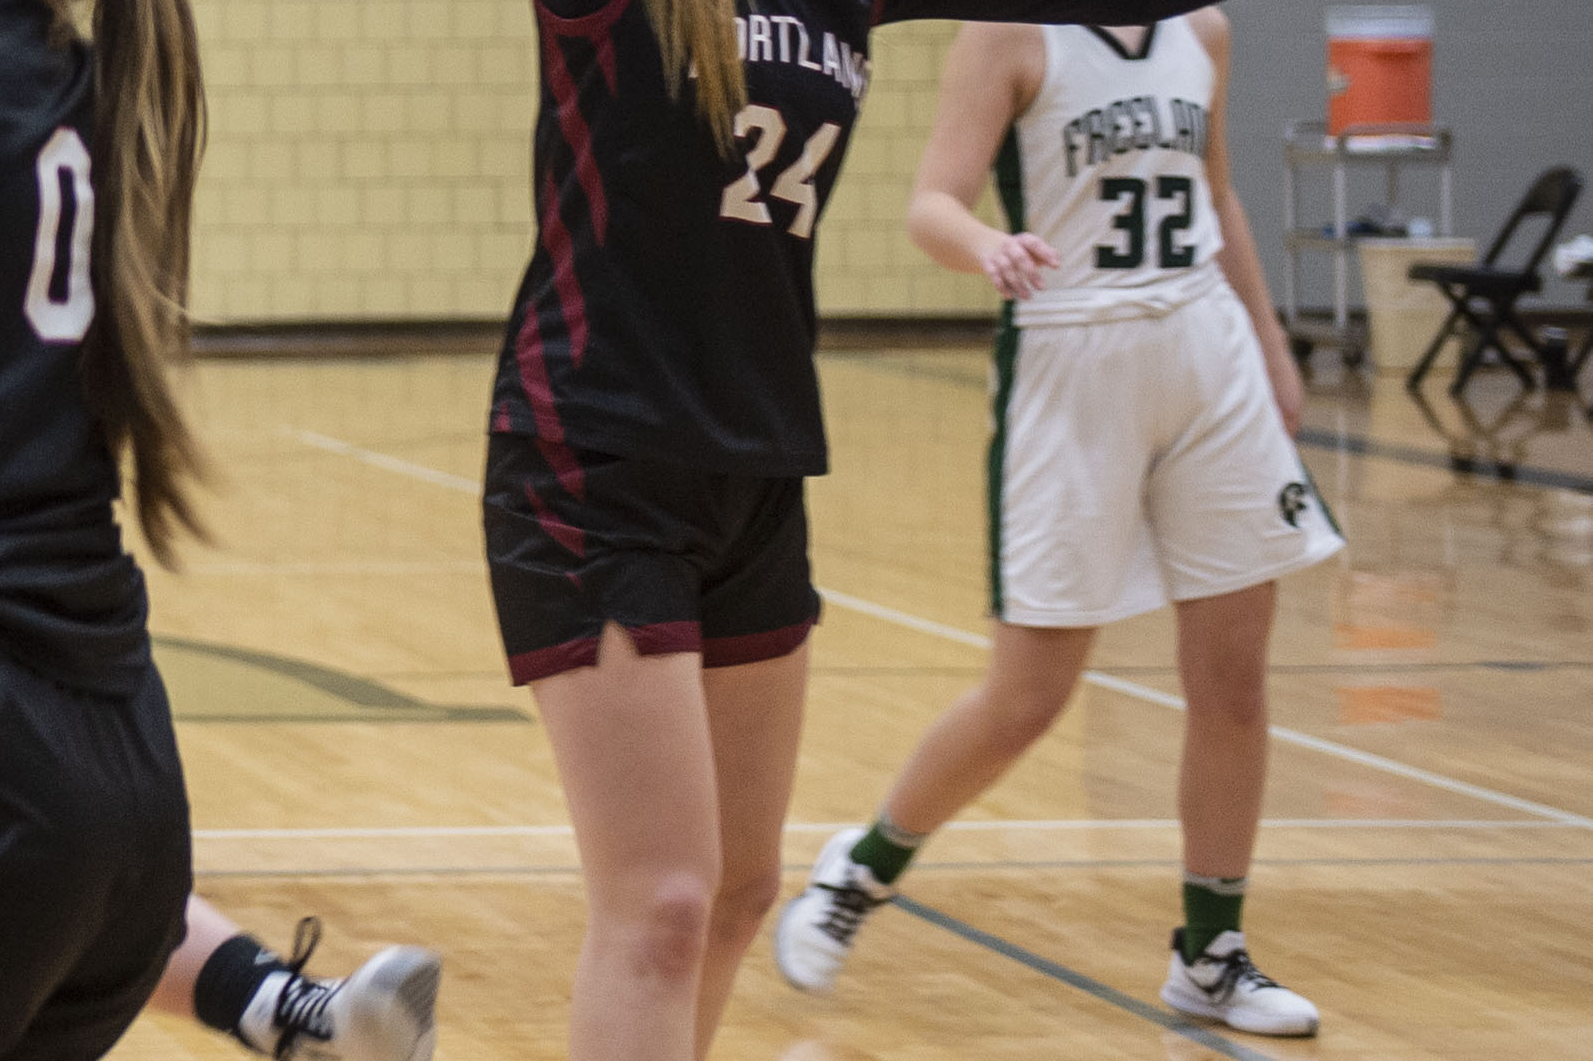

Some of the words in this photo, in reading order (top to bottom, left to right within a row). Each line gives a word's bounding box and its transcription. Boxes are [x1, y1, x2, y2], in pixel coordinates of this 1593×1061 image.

[24, 126, 96, 342] 0
[719, 104, 842, 239] 24
[1095, 176, 1197, 269] 32
